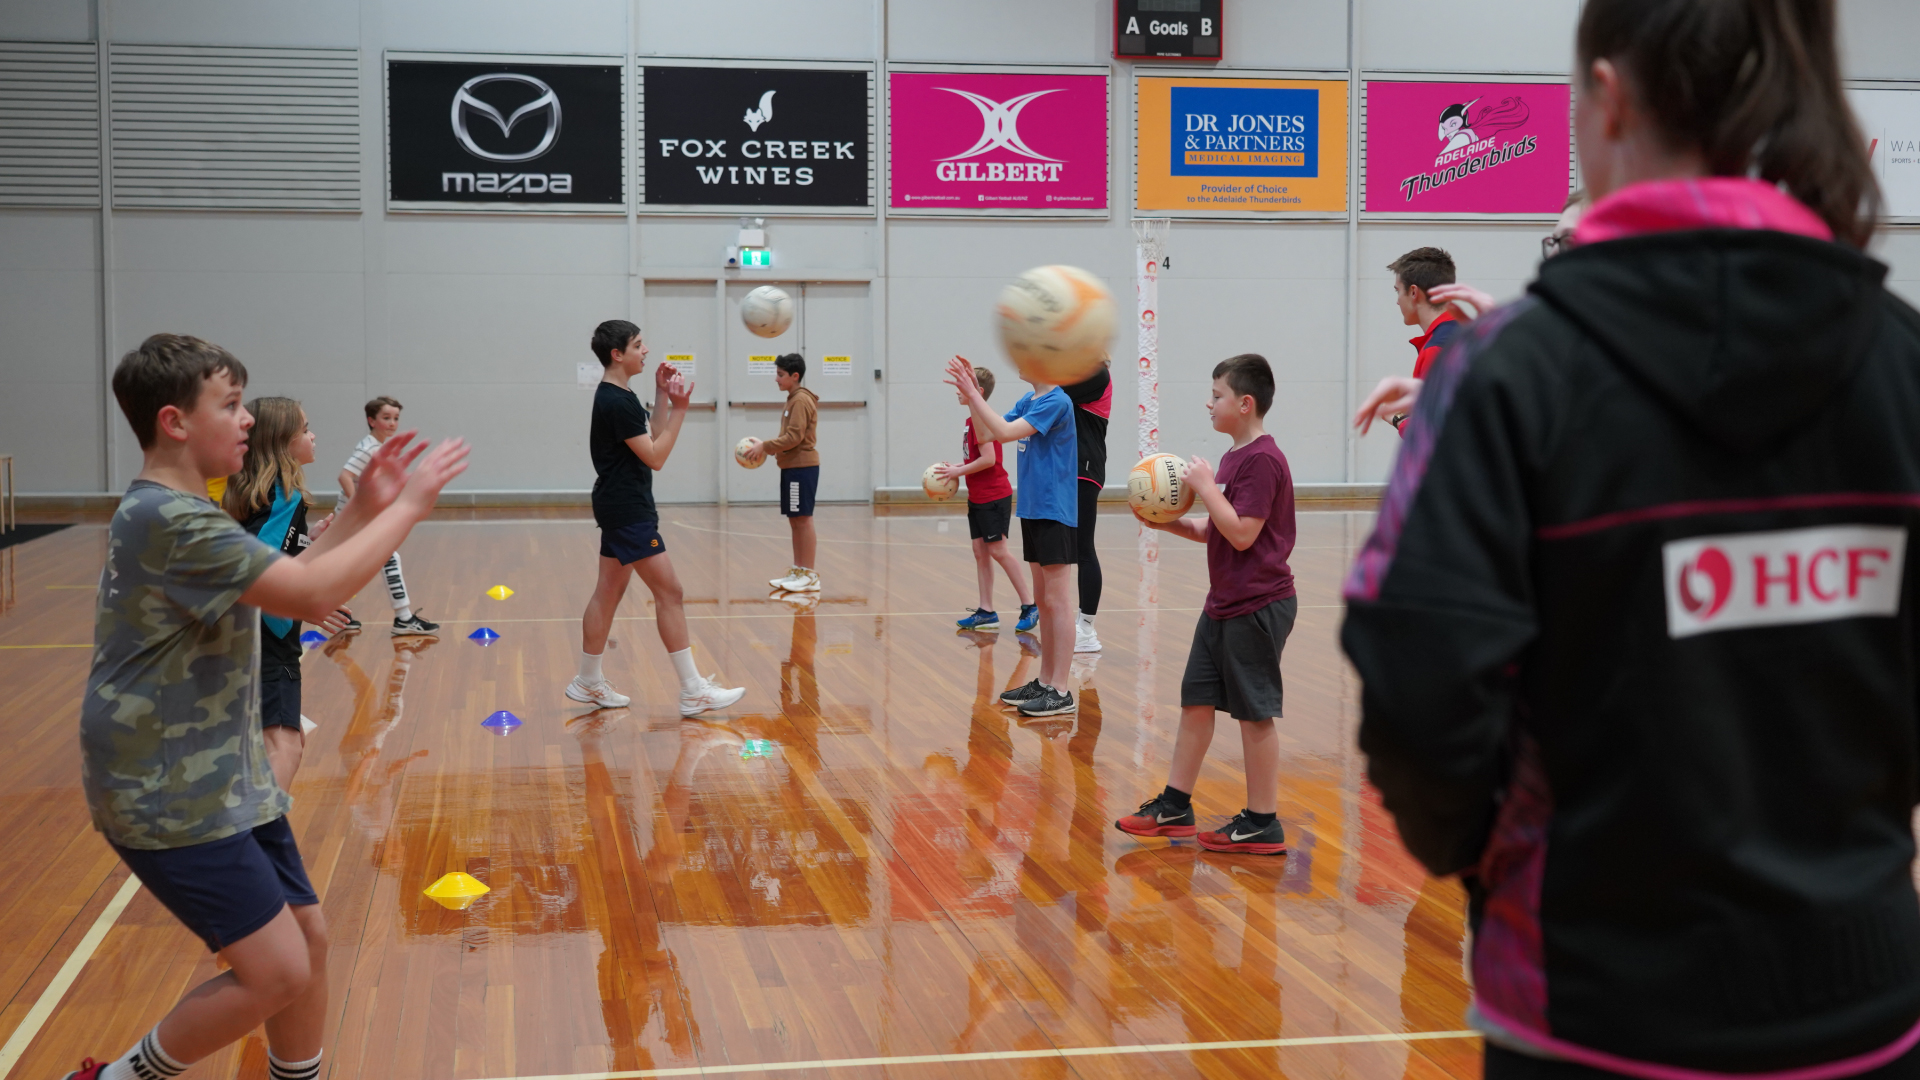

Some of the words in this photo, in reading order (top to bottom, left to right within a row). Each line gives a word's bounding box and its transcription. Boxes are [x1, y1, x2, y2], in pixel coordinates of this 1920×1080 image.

[1125, 16, 1140, 35] A
[1149, 19, 1189, 36] Goals
[1201, 17, 1213, 36] B
[1185, 113, 1219, 132] DR
[1227, 114, 1305, 133] JONES
[659, 138, 727, 158] FOX
[741, 140, 855, 160] CREEK
[1185, 134, 1200, 150] &
[1205, 134, 1305, 151] PARTNERS
[1434, 136, 1496, 167] ADELAIDE
[1890, 140, 1920, 152] WA
[1189, 154, 1243, 163] MEDICAL
[1248, 155, 1301, 163] IMAGING
[1400, 135, 1537, 202] Thunderbirds
[696, 165, 814, 186] WINES
[936, 162, 1063, 182] GILBERT
[1201, 184, 1242, 193] Provider
[1244, 184, 1255, 193] of
[1256, 184, 1288, 193] Choice
[1197, 195, 1211, 203] the
[1212, 195, 1247, 203] Adelaide
[1162, 256, 1171, 270] 4
[1165, 459, 1179, 506] GILBERT
[789, 481, 800, 512] PUMA
[1752, 546, 1892, 608] HCF
